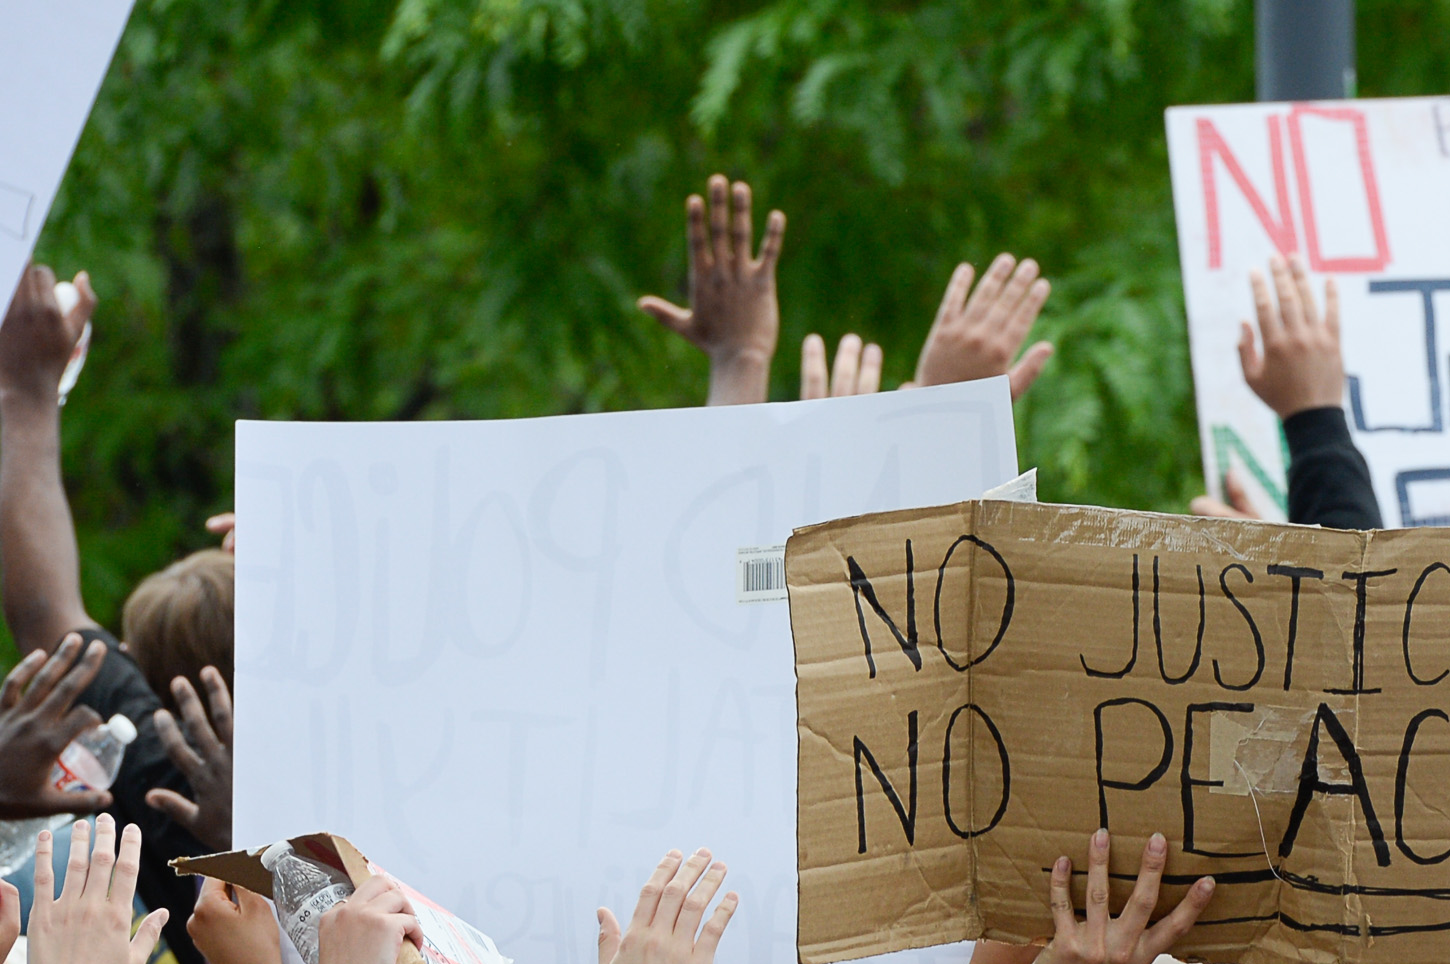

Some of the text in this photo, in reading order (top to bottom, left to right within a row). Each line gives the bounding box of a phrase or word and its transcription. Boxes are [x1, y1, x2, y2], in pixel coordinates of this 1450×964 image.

[1196, 102, 1392, 272] NO
[847, 534, 1016, 680] NO
[852, 703, 1011, 855] NO
